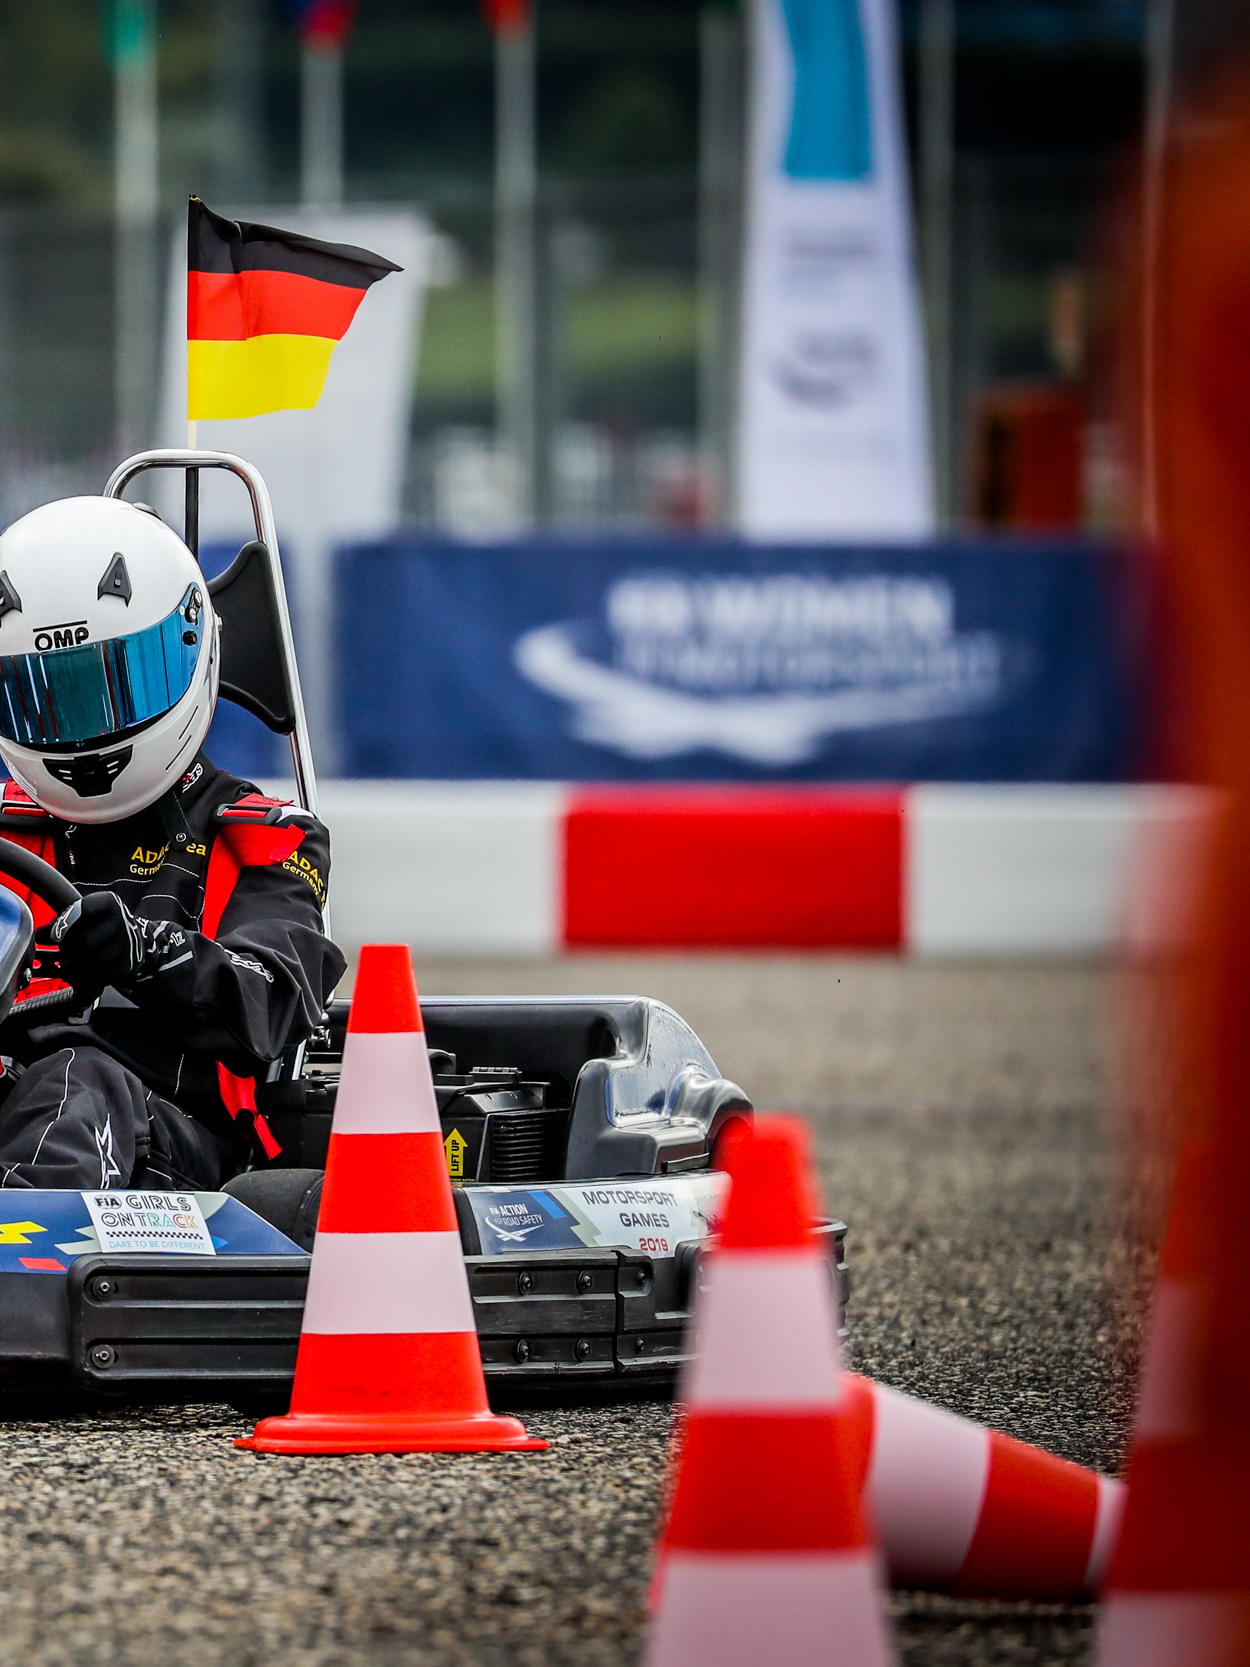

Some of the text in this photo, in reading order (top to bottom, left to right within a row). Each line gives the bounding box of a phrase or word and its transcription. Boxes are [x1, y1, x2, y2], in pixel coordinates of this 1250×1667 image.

[34, 626, 89, 651] OMP
[451, 1139, 460, 1172] LIFT UP
[126, 1194, 192, 1211] GIRLS
[582, 1190, 678, 1206] MOTORSPORT
[499, 1203, 529, 1217] ACTION
[503, 1215, 522, 1227] ROAD
[519, 1213, 543, 1226] SAFETY
[619, 1212, 670, 1227] GAMES
[109, 1240, 205, 1250] DARE TO BE DIFFERENT
[638, 1237, 669, 1252] 2019
